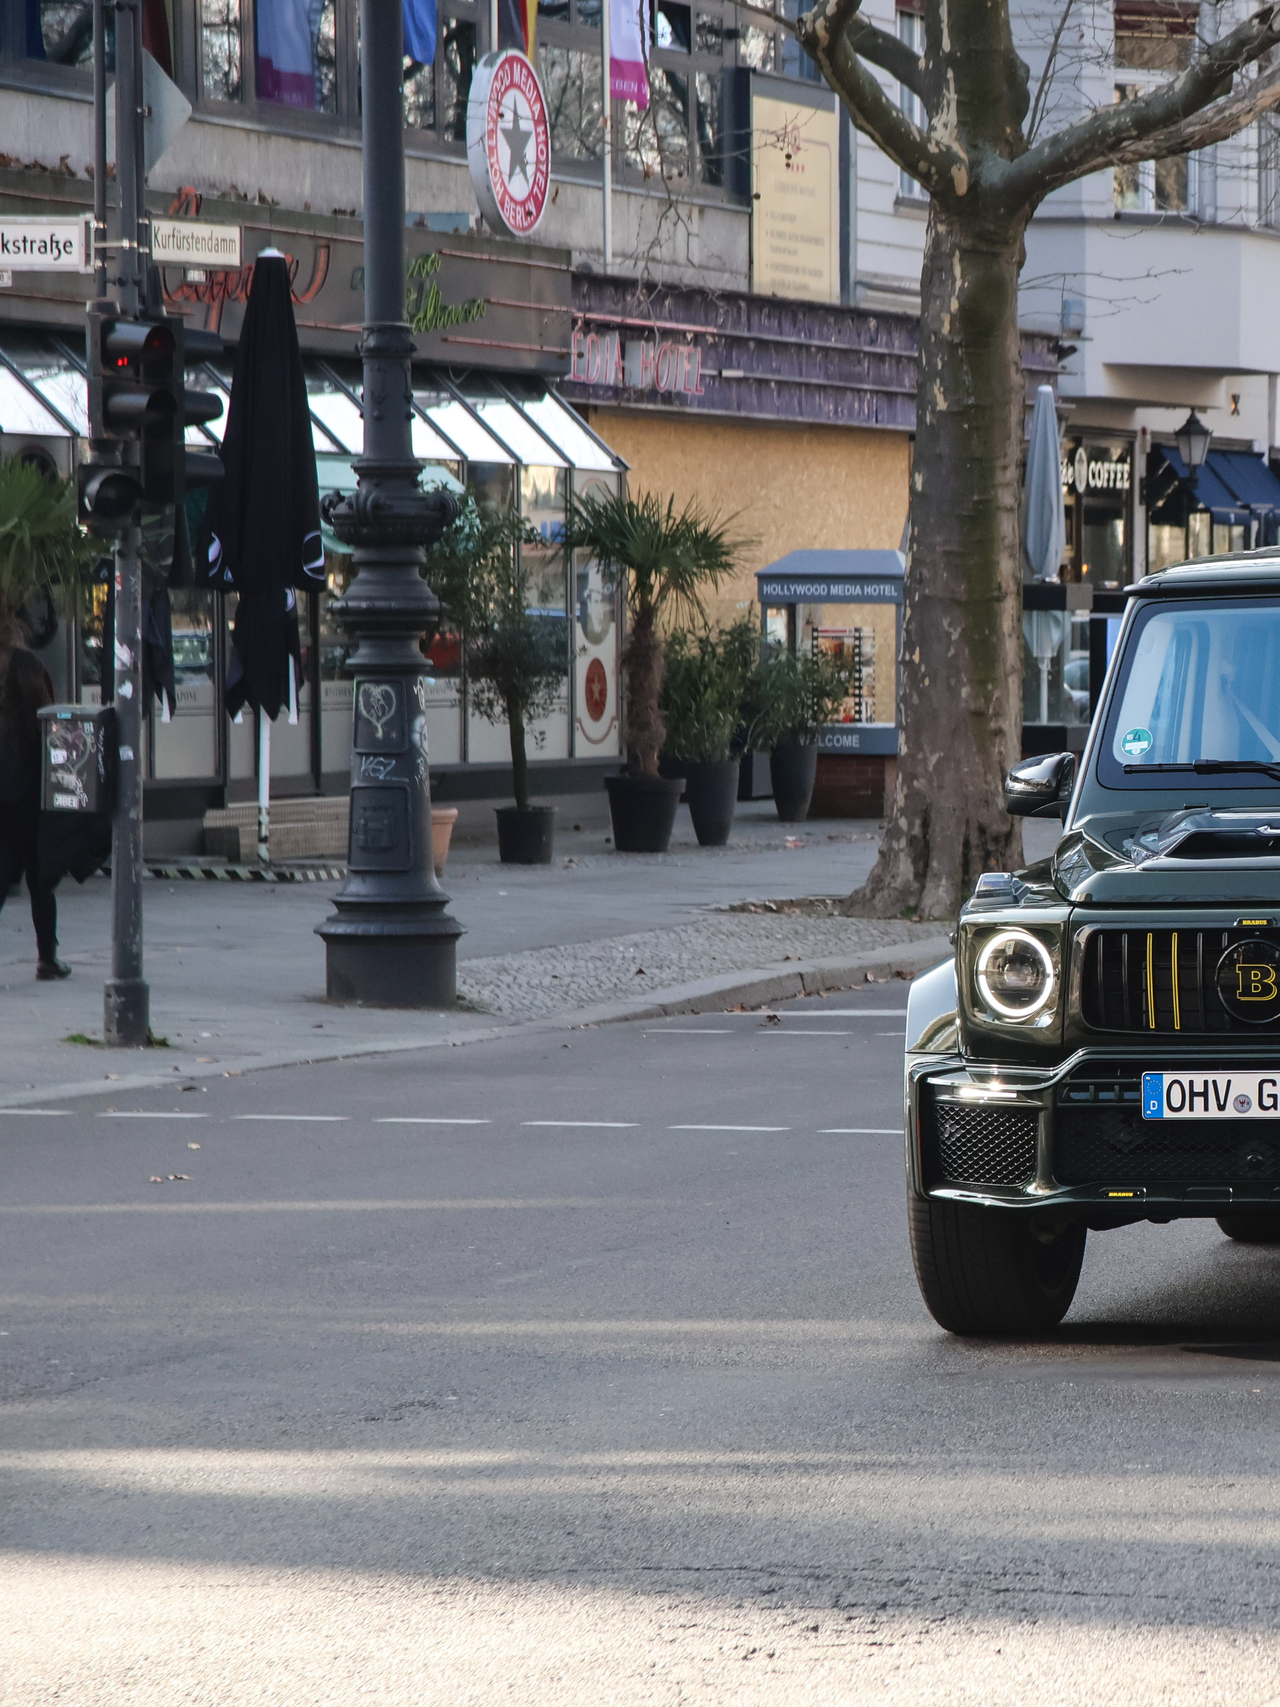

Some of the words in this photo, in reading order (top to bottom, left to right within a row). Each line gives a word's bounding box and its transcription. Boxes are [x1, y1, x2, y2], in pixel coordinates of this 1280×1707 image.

[513, 61, 541, 121] MEDIA
[533, 125, 548, 201] HOTEL
[152, 225, 238, 256] Kurfürstendamm
[569, 330, 624, 388] EDIA
[640, 340, 705, 395] HOTEL
[1088, 459, 1131, 490] COFFEE
[762, 583, 828, 597] HOLLYWOOD
[830, 584, 862, 597] MEDIA
[864, 585, 898, 597] HOTEL
[1236, 963, 1278, 1001] B
[1150, 1100, 1158, 1111] D
[1166, 1078, 1232, 1113] OHV
[1257, 1078, 1279, 1112] G
